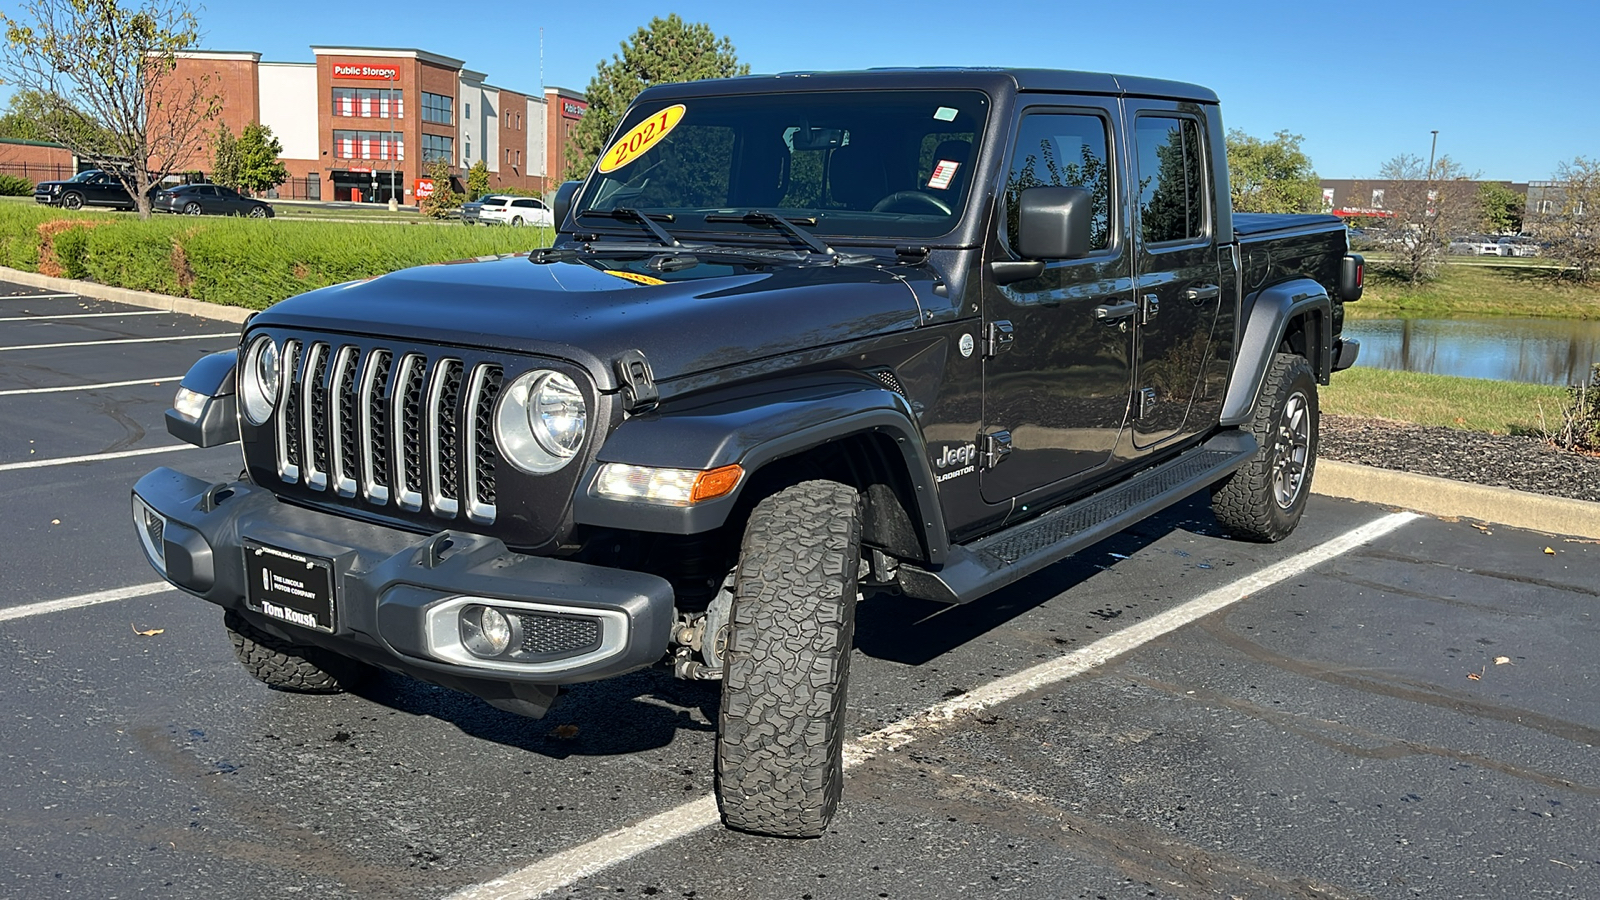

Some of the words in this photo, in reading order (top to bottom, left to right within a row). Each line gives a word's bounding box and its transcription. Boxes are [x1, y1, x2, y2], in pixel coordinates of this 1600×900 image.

[335, 66, 361, 75] Public
[362, 66, 395, 78] Storage
[615, 112, 668, 165] 2021
[416, 188, 433, 196] Stor
[419, 181, 433, 190] Pub
[936, 444, 976, 468] Jeep
[273, 574, 283, 583] THE
[283, 577, 304, 589] LINCOLN
[274, 582, 291, 594] MOTOR
[291, 587, 316, 599] COMPANY
[261, 600, 284, 619] Tom
[284, 606, 317, 628] Roush
